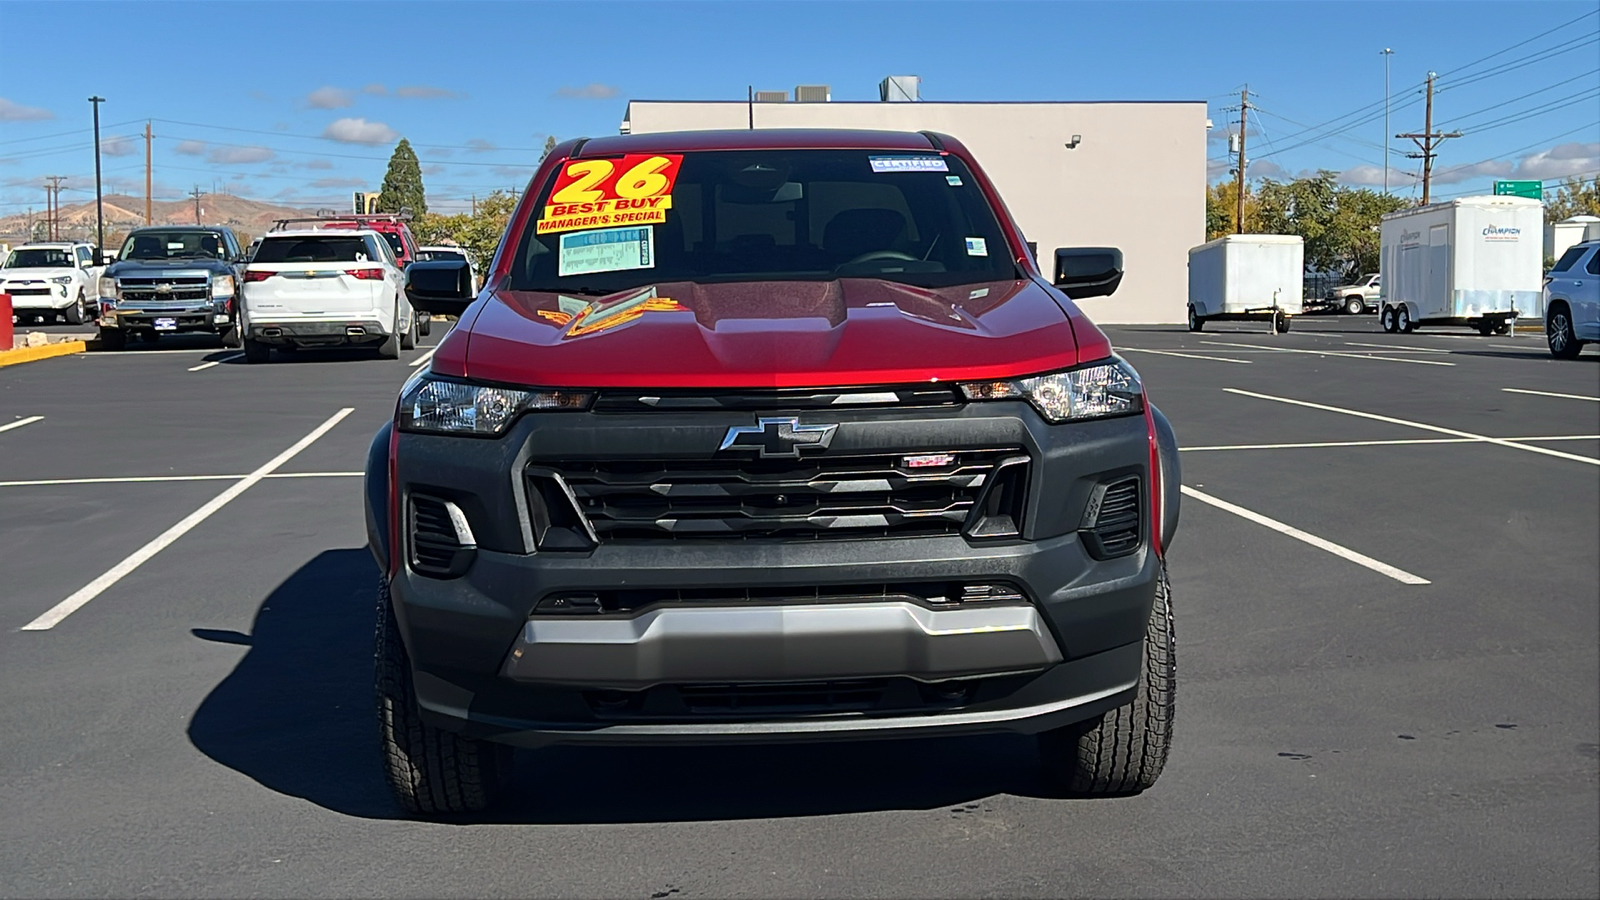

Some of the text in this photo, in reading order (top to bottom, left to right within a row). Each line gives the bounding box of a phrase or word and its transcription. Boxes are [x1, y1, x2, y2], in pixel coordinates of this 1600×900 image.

[874, 160, 943, 168] CERTIFIED
[553, 156, 673, 203] 26
[551, 197, 664, 217] BEST BUY
[538, 211, 663, 231] MANAGER'S SPECIAL
[1482, 227, 1521, 236] CHAMPION
